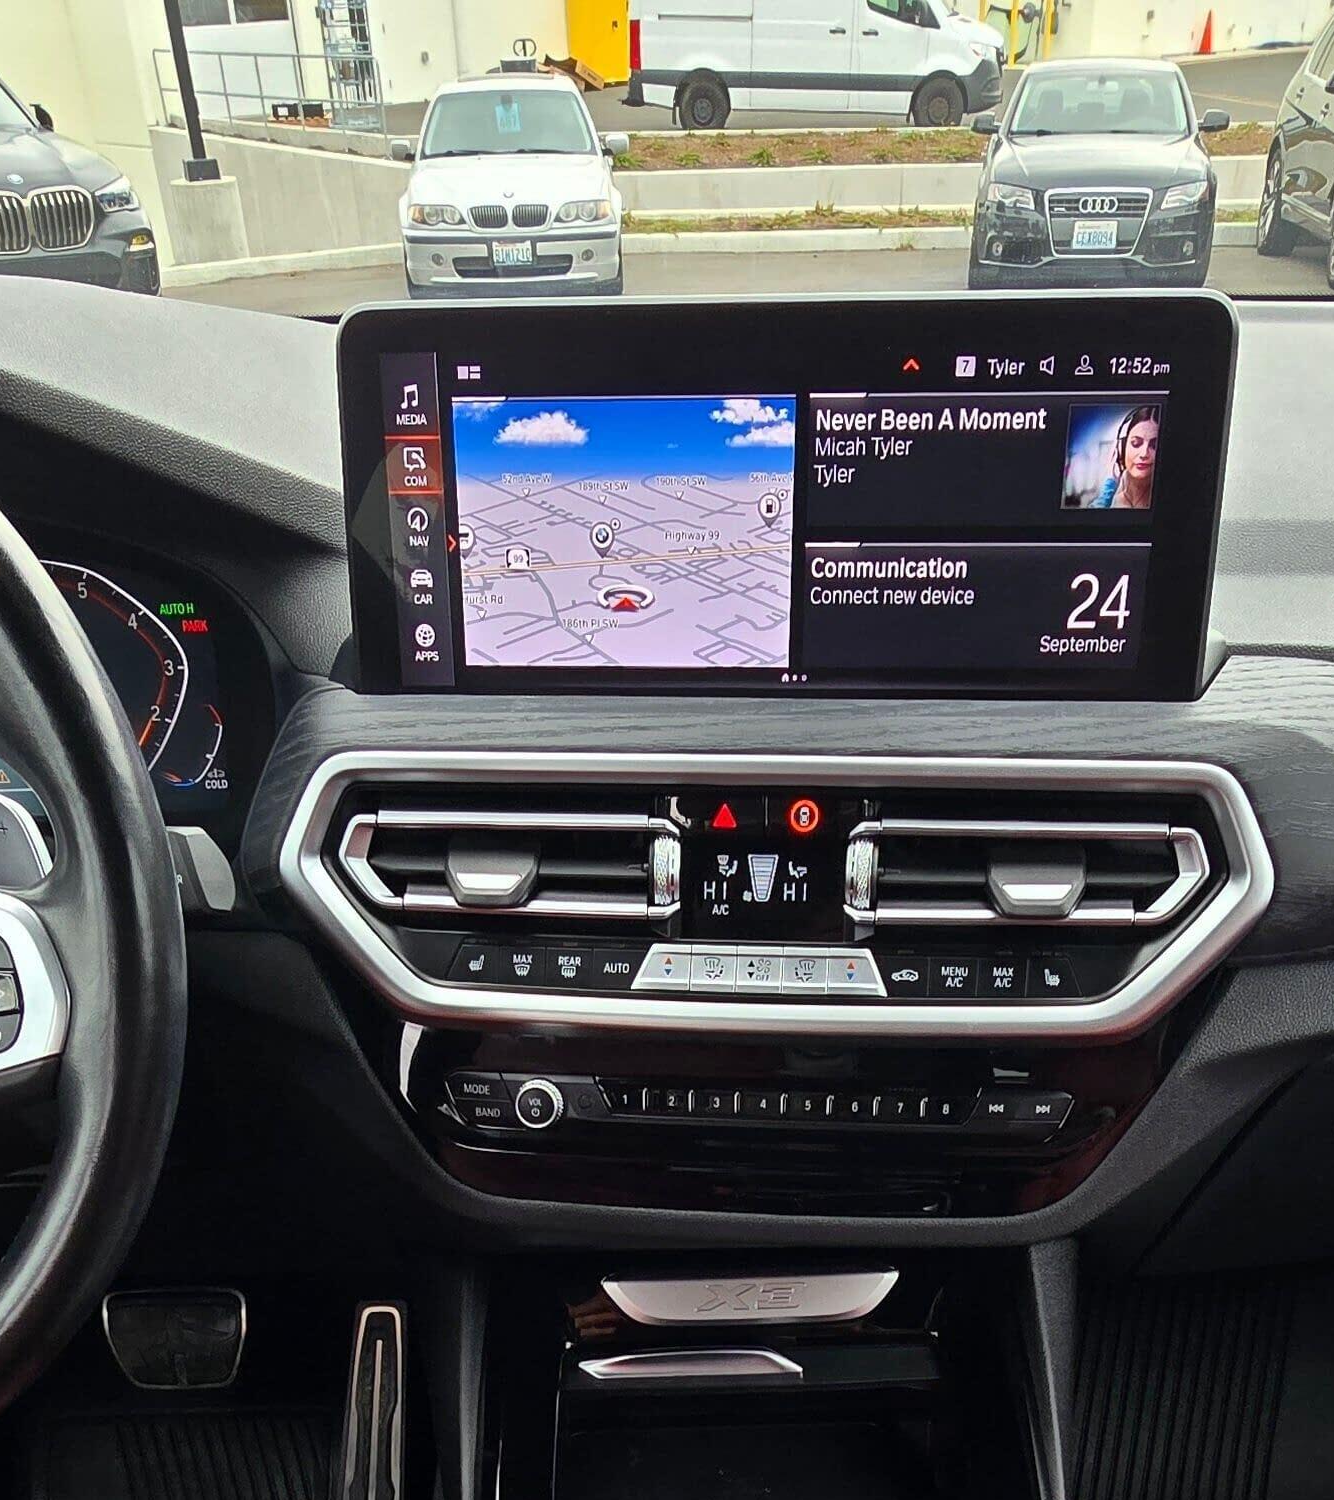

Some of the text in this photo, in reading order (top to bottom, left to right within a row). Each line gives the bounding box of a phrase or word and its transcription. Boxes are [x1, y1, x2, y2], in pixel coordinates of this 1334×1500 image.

[988, 359, 1025, 379] Tyler
[1110, 357, 1151, 374] 12:52
[1153, 363, 1170, 376] pm
[396, 414, 427, 425] MEDIA
[816, 408, 1047, 431] Never Been A Moment
[815, 437, 913, 459] Micah Tyler
[503, 474, 524, 484] 52nd
[525, 474, 541, 484] Ave
[814, 464, 855, 486] Tyler
[404, 475, 427, 487] COM
[579, 482, 629, 491] 189th St SW
[681, 478, 692, 486] St
[692, 478, 706, 486] SW
[409, 536, 429, 547] NAV
[665, 531, 720, 541] Highway 99
[513, 554, 524, 563] 99
[811, 557, 968, 579] Communication
[78, 582, 88, 599] 5
[810, 586, 974, 605] Connect new device
[414, 594, 433, 605] CAR
[491, 594, 503, 604] Rd
[1066, 573, 1131, 630] 24
[160, 603, 194, 615] AUTO H
[128, 613, 138, 630] 4
[182, 620, 208, 632] PARK
[562, 618, 589, 628] 186th
[602, 618, 618, 628] SW
[1039, 635, 1126, 655] September
[415, 651, 439, 662] APPS
[164, 660, 174, 675] 3
[150, 705, 160, 721] 2
[205, 779, 228, 789] COLD
[703, 881, 727, 900] HI
[783, 882, 807, 901] HI
[712, 904, 729, 915] A/C
[513, 955, 533, 964] MAX
[558, 956, 581, 966] REAR
[603, 963, 630, 974] AUTO
[941, 966, 968, 977] MENU
[993, 967, 1014, 977] MAX
[755, 974, 770, 982] OFF
[945, 977, 963, 988] A/C
[994, 977, 1012, 988] A/C
[463, 1083, 491, 1095] MODE
[528, 1097, 542, 1107] VOL
[622, 1094, 628, 1104] 1
[668, 1096, 675, 1106] 2
[713, 1097, 720, 1108] 3
[759, 1098, 766, 1109] 4
[804, 1100, 811, 1111] 5
[851, 1101, 858, 1112] 6
[897, 1102, 904, 1113] 7
[942, 1103, 949, 1114] 8
[475, 1107, 501, 1117] BAND
[694, 1281, 806, 1312] X3
